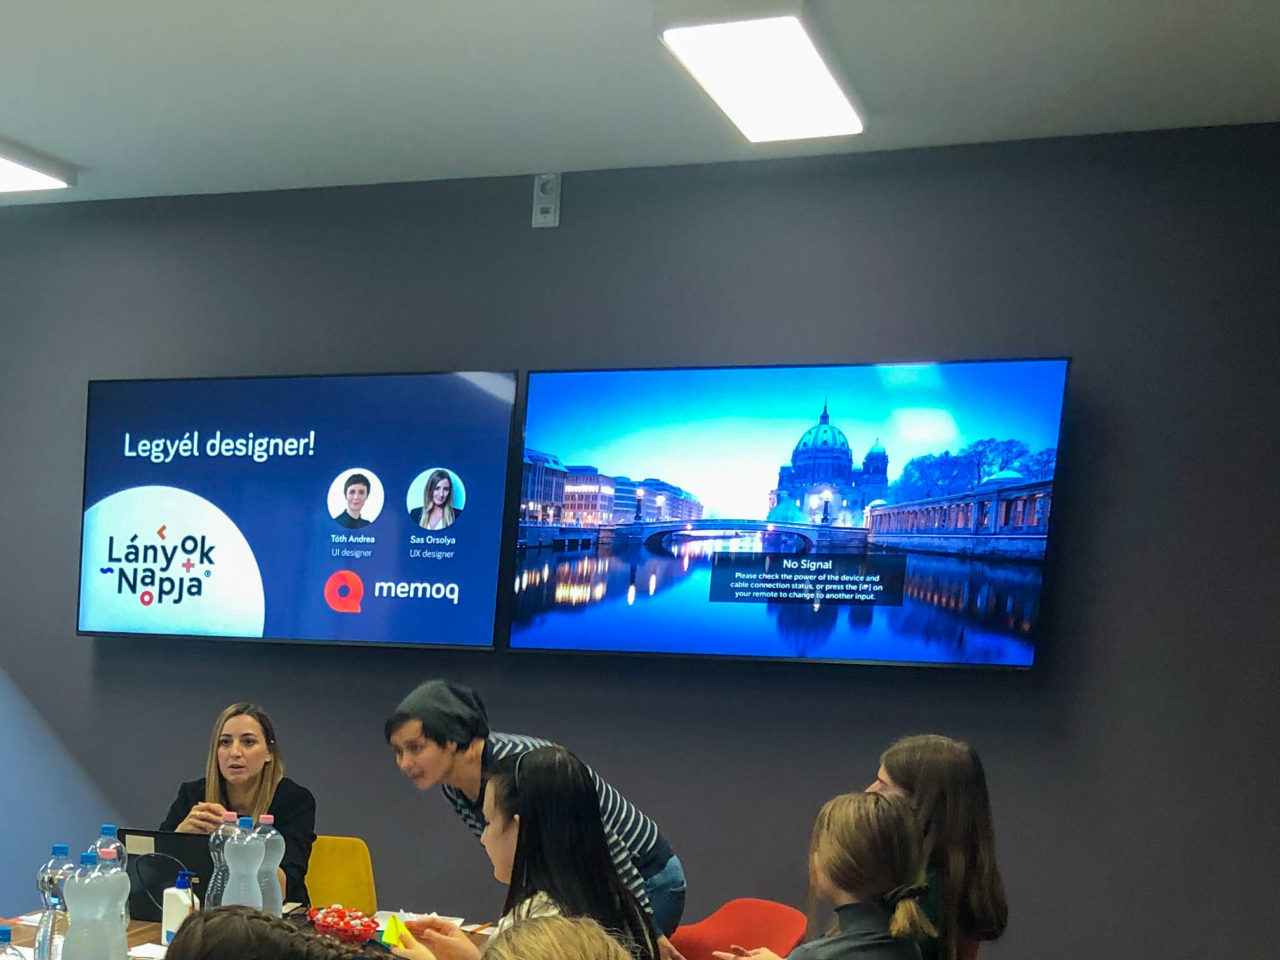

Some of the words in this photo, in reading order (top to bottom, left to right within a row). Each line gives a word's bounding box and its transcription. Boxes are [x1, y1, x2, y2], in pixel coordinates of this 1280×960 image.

[124, 430, 199, 463] Legyél
[206, 430, 315, 463] designer!
[331, 534, 347, 543] Tóth
[348, 534, 375, 543] Andrea
[410, 535, 424, 544] Sas
[426, 535, 456, 546] Orsolya
[108, 533, 216, 573] Lányok
[341, 548, 372, 558] designer
[409, 549, 421, 558] UX
[422, 549, 454, 560] designer
[782, 559, 799, 569] No
[800, 559, 833, 571] Signal
[735, 572, 757, 580] Please
[840, 574, 865, 582] device
[117, 567, 203, 605] Napja
[845, 583, 858, 591] the
[374, 581, 459, 605] memoq
[788, 591, 815, 600] change
[825, 592, 854, 600] another
[854, 593, 876, 602] input.
